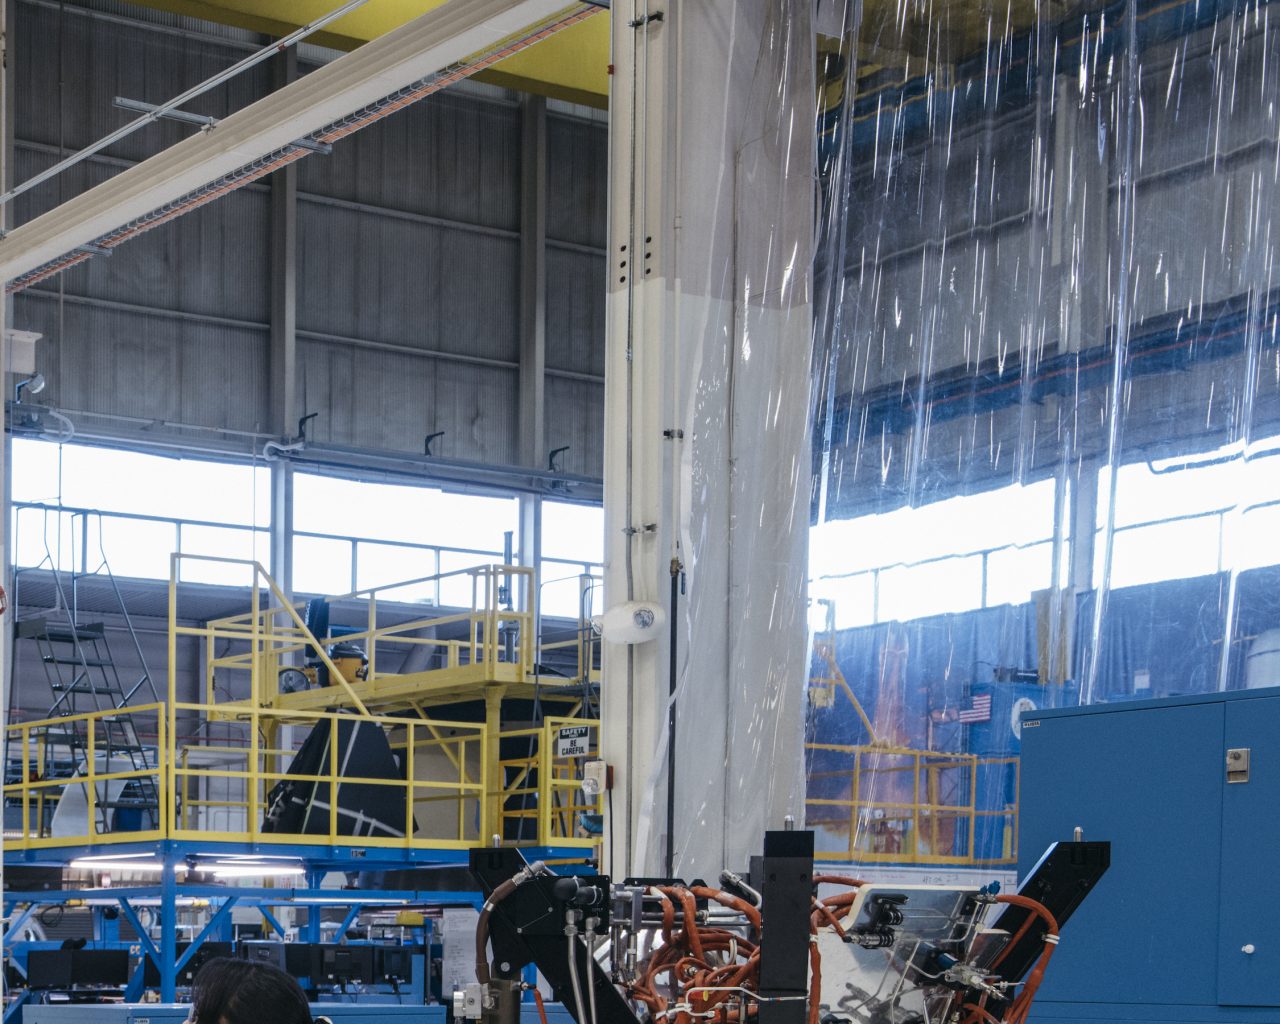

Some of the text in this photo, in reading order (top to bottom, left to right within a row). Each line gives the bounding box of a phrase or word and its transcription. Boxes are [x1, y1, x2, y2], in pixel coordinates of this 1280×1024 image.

[561, 727, 586, 736] SAFETY
[569, 739, 577, 748] BE
[561, 746, 585, 756] CAREFUL
